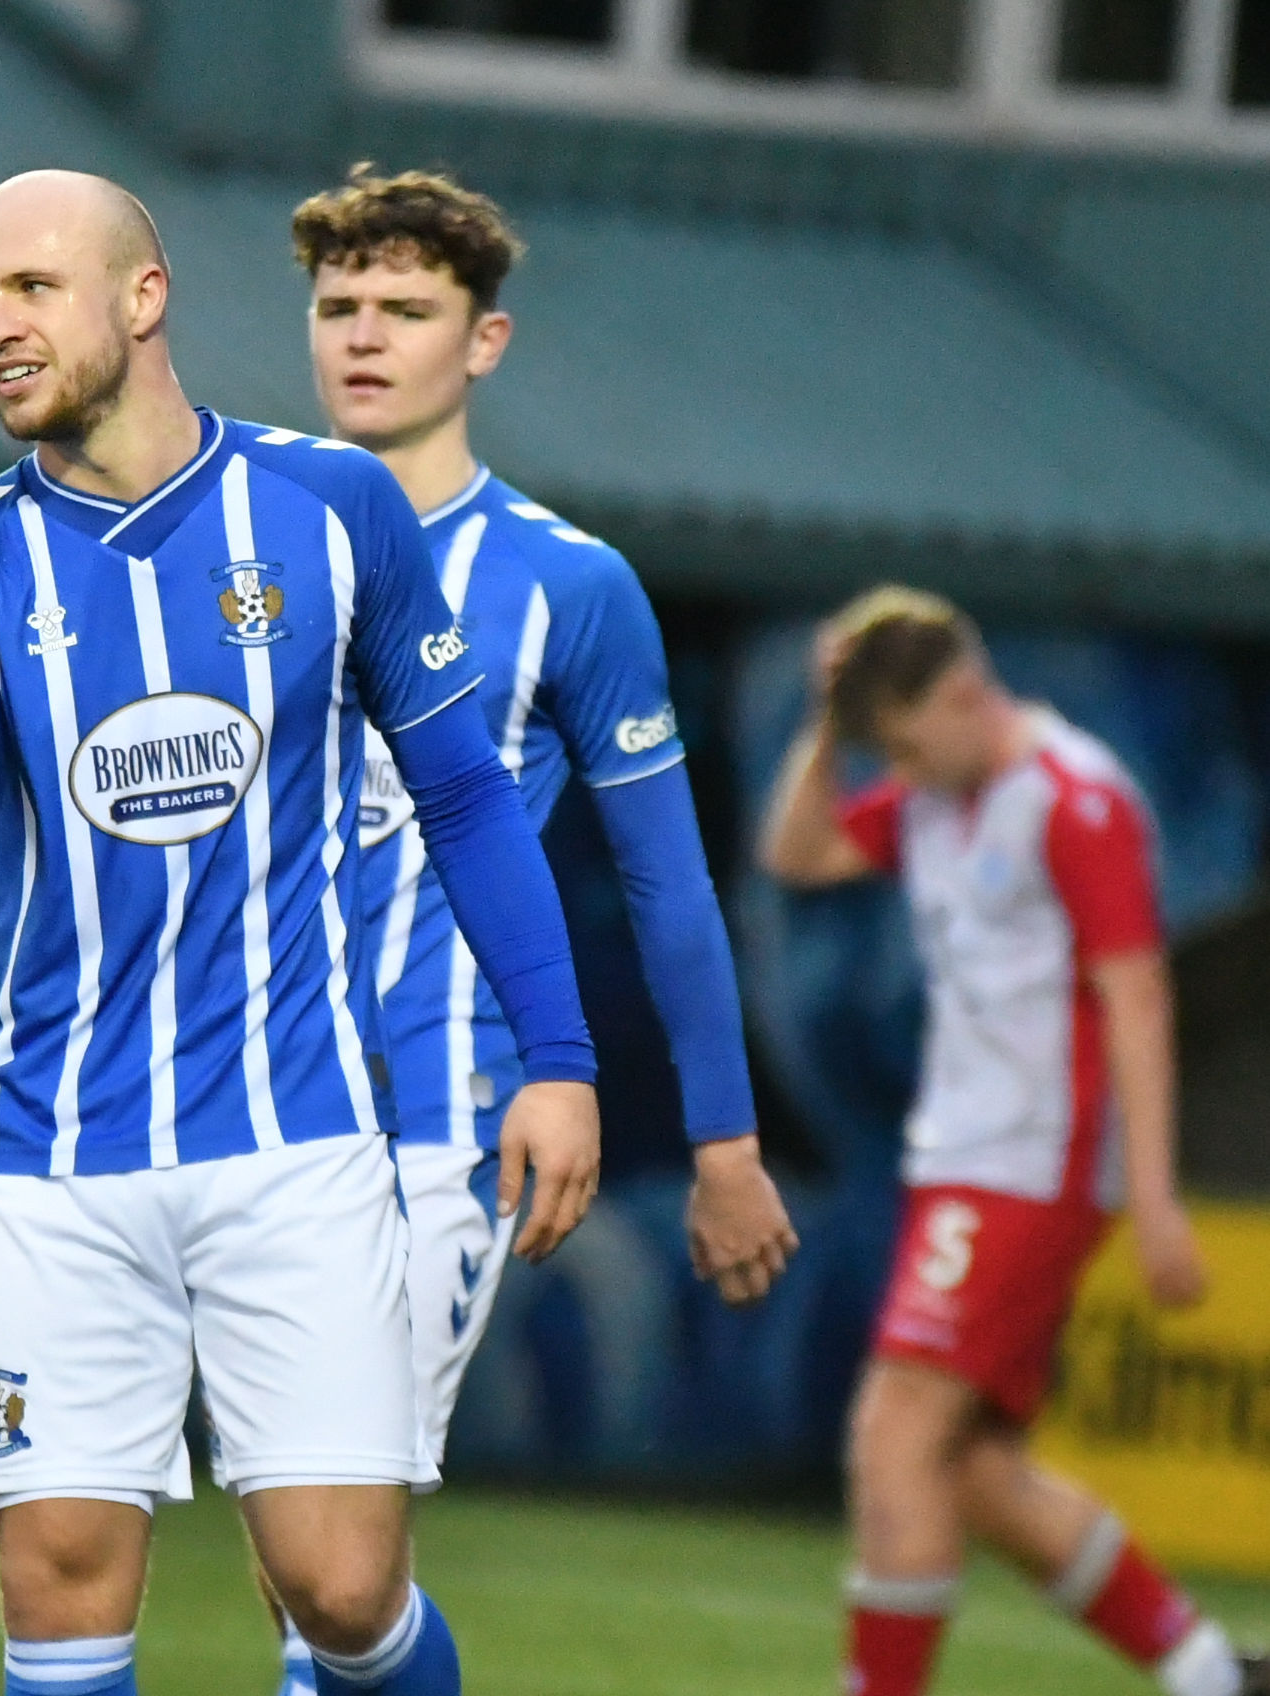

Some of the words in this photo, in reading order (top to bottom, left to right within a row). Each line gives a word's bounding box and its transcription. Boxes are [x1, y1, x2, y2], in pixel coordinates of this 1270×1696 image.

[90, 722, 245, 793] BROWNINGS
[120, 799, 153, 814] THE
[159, 788, 225, 809] BAKERS
[918, 1200, 981, 1290] 5
